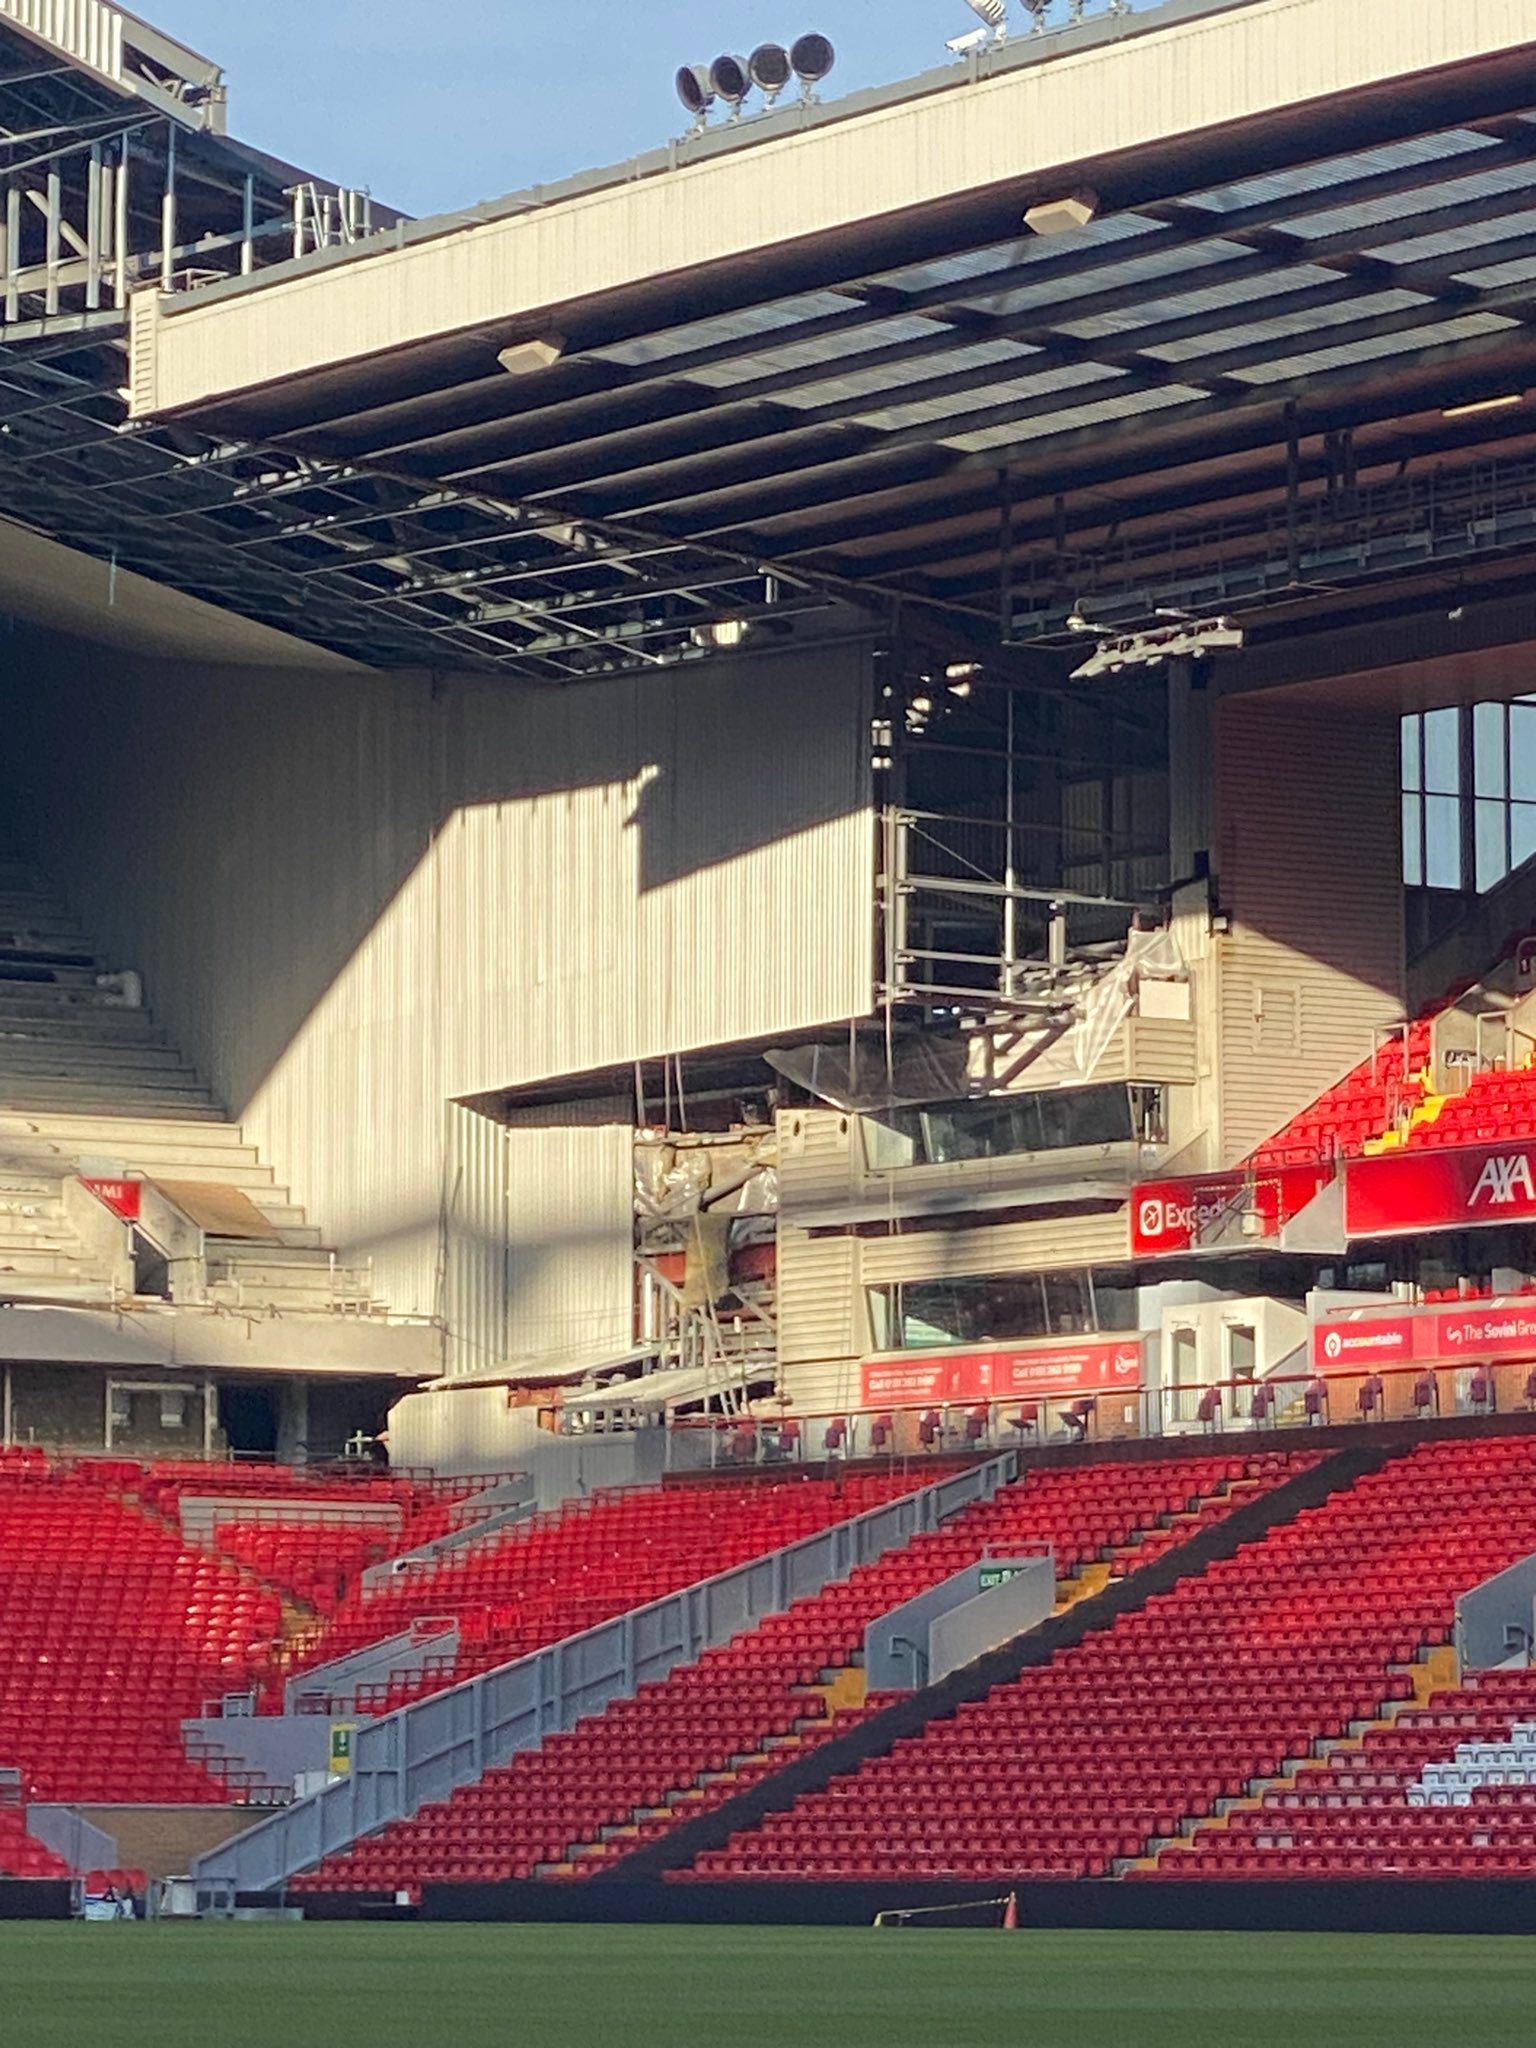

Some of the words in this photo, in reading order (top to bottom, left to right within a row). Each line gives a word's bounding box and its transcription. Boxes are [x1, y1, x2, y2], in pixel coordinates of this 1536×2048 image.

[1466, 1154, 1536, 1207] AXA
[1463, 1324, 1483, 1341] The
[1517, 1319, 1536, 1337] Gro
